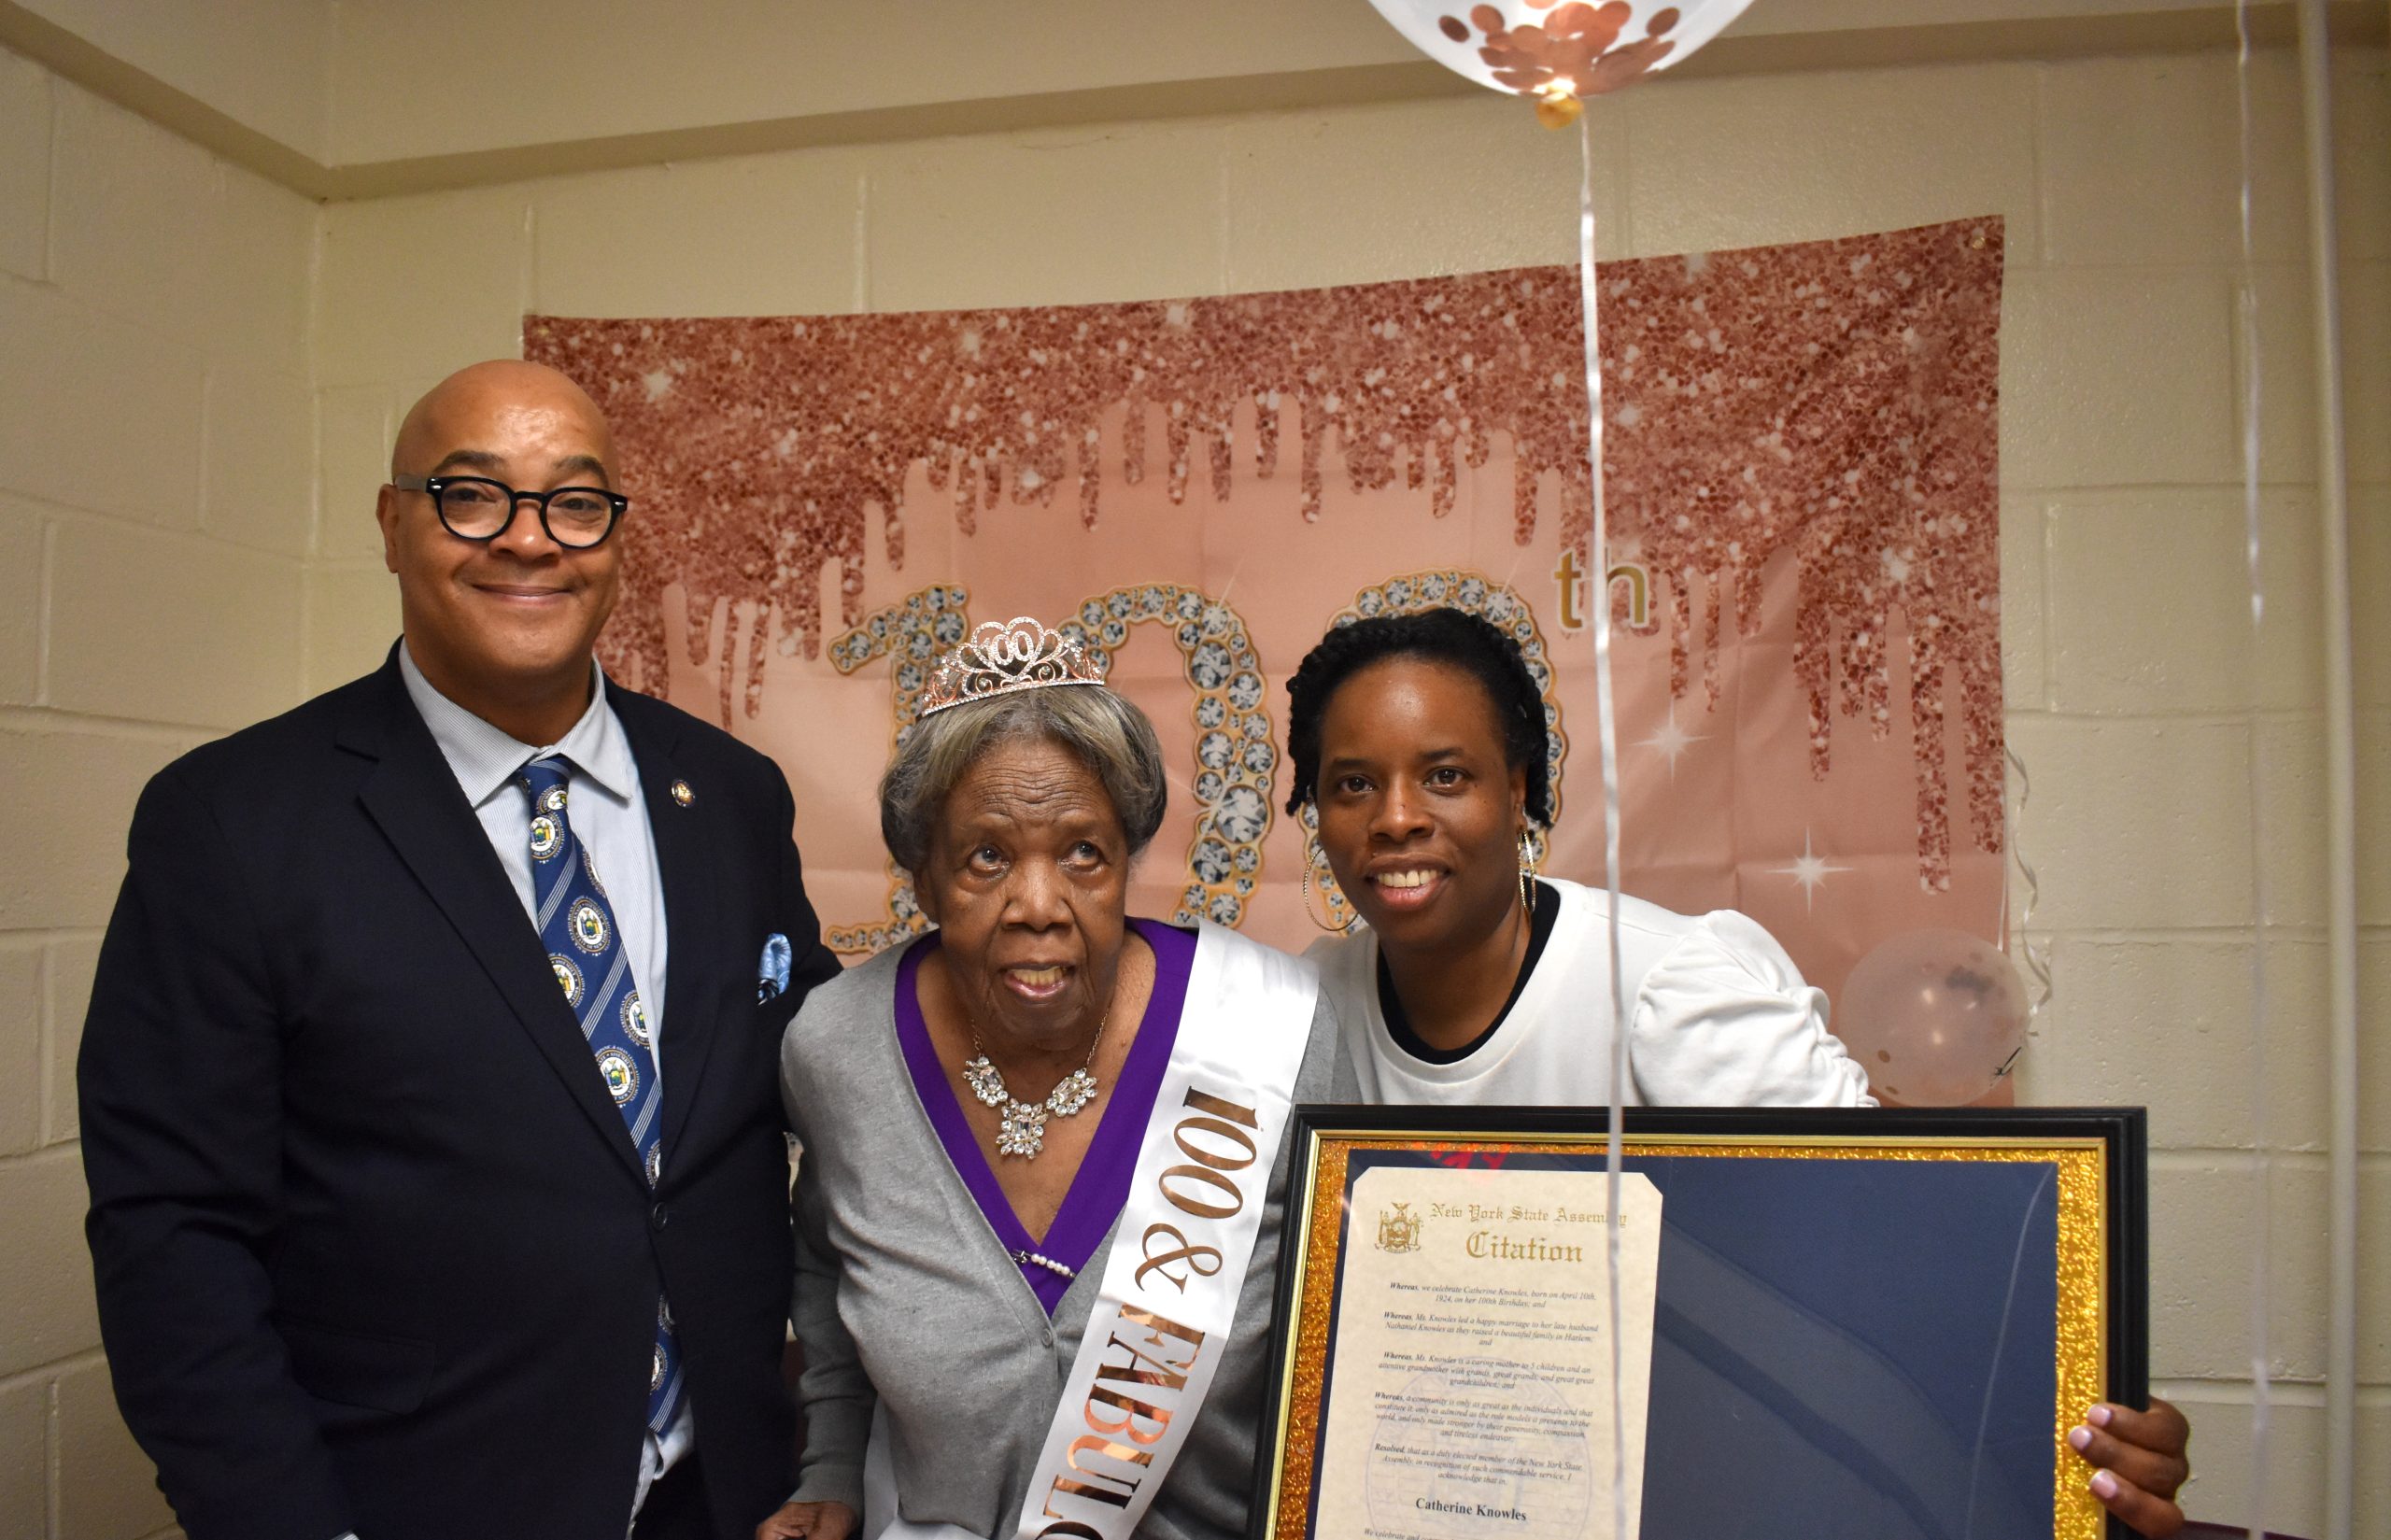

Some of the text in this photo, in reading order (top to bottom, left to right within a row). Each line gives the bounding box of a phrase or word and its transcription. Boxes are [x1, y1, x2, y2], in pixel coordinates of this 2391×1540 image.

[1553, 546, 1647, 629] th
[1158, 1085, 1263, 1220] 100
[1430, 1202, 1628, 1228] New York State Assemy
[1134, 1222, 1224, 1296] &
[1465, 1230, 1584, 1262] Citation
[1415, 1497, 1527, 1521] Catherine Knowles
